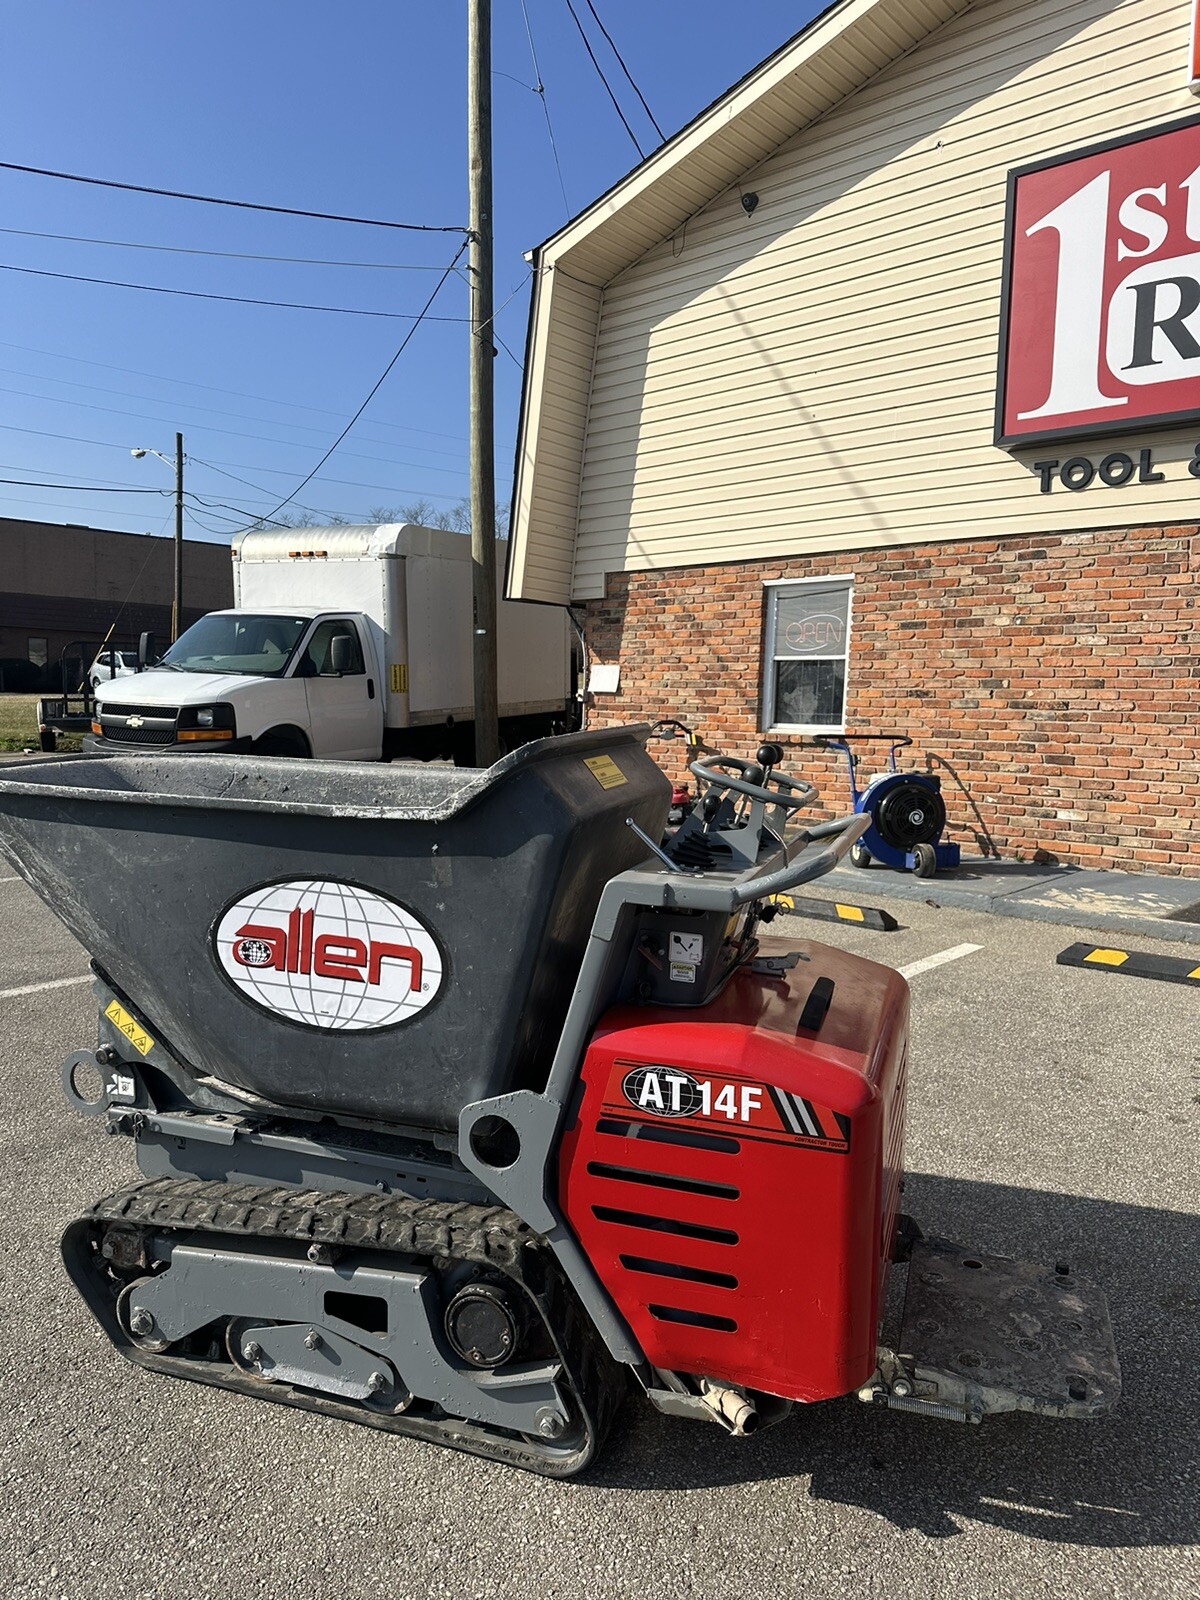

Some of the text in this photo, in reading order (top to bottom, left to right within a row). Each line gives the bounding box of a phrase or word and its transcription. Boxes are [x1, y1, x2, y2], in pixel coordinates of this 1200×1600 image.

[1034, 448, 1166, 494] TOOL
[785, 621, 843, 644] OPEN
[232, 906, 424, 993] allen
[638, 1072, 763, 1122] AT 14F
[794, 1136, 827, 1146] CONTRACTOR
